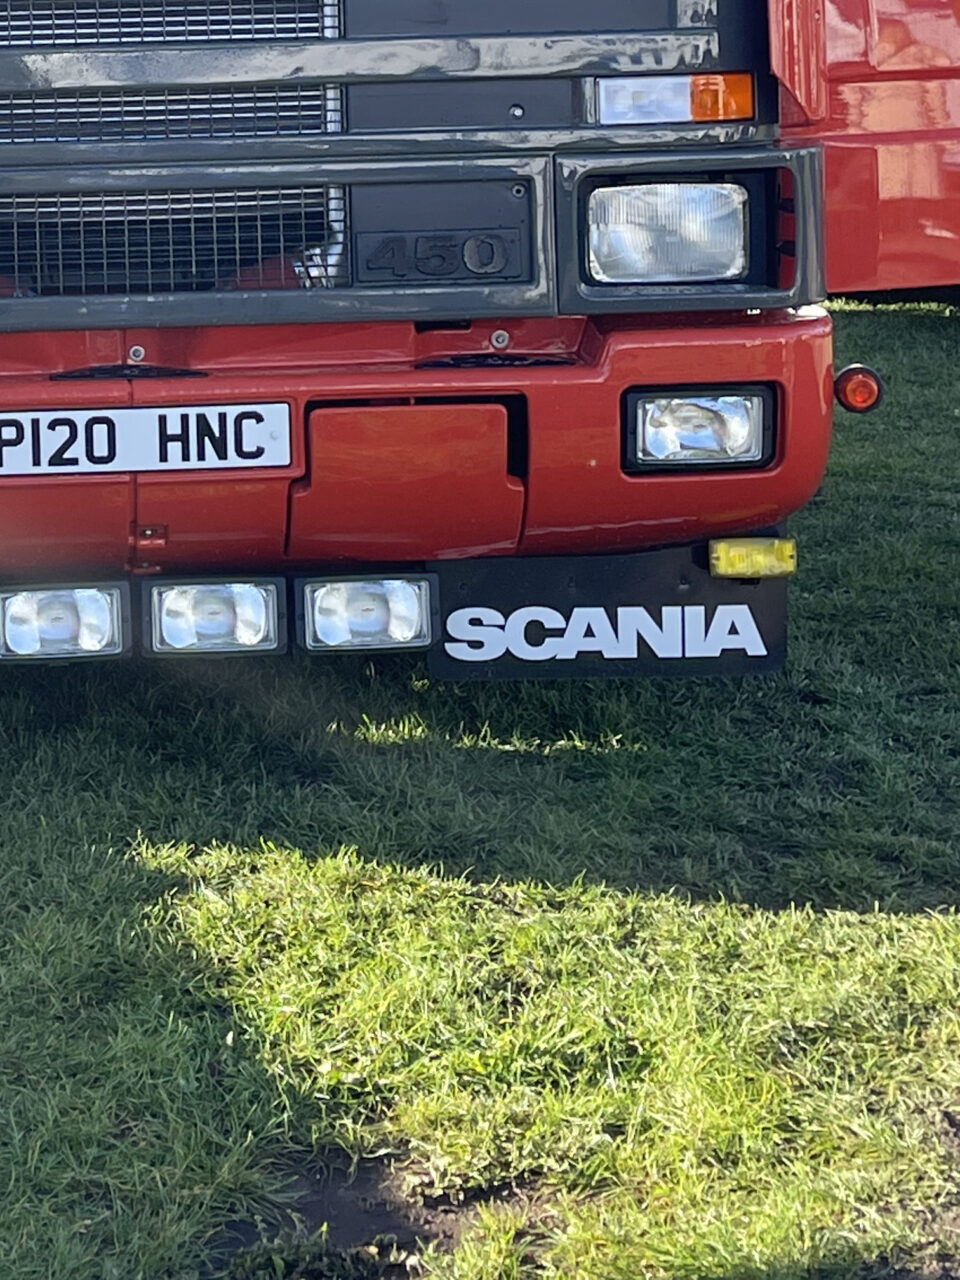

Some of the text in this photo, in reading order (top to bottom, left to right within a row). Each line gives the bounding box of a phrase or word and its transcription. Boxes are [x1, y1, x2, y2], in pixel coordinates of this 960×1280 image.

[366, 233, 509, 278] 450
[158, 410, 266, 463] HNC
[444, 604, 768, 662] SCANIA
